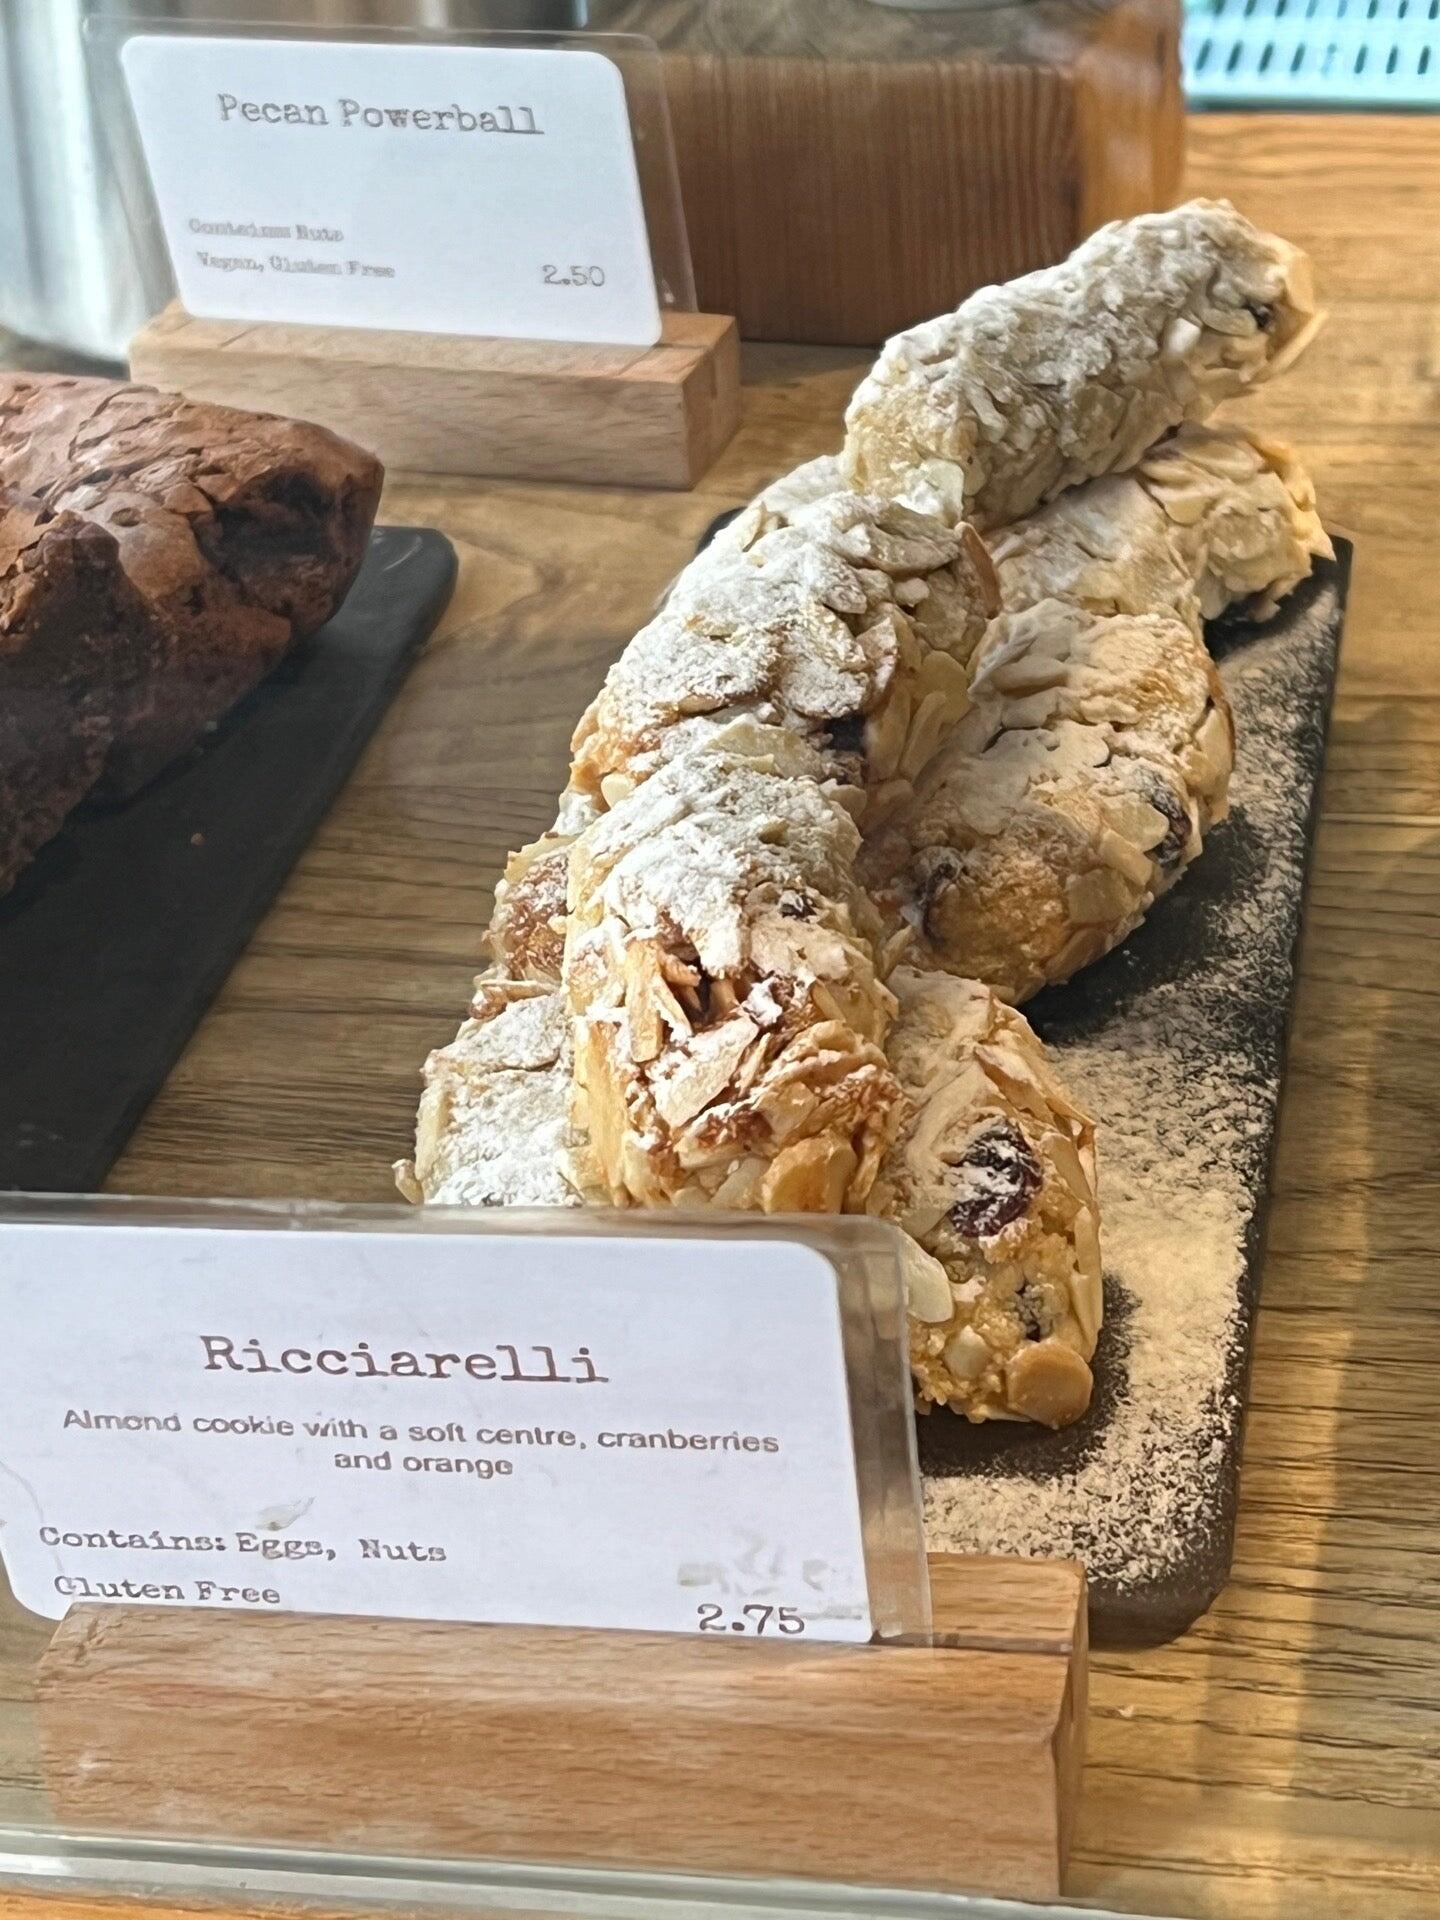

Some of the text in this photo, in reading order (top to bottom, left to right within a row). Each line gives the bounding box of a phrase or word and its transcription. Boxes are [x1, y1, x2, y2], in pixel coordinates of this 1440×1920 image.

[218, 94, 546, 135] Pecan Powerball
[348, 260, 396, 279] Free
[543, 265, 607, 288] 2.50
[200, 1335, 611, 1384] Ricciarelli
[64, 1410, 781, 1454] Almond cookie with a soft centre, cranberries
[335, 1450, 514, 1480] and orange
[40, 1526, 448, 1563] Contains: Eggs, Nuts
[54, 1575, 282, 1605] Gluten Free
[697, 1603, 806, 1635] 2.75
